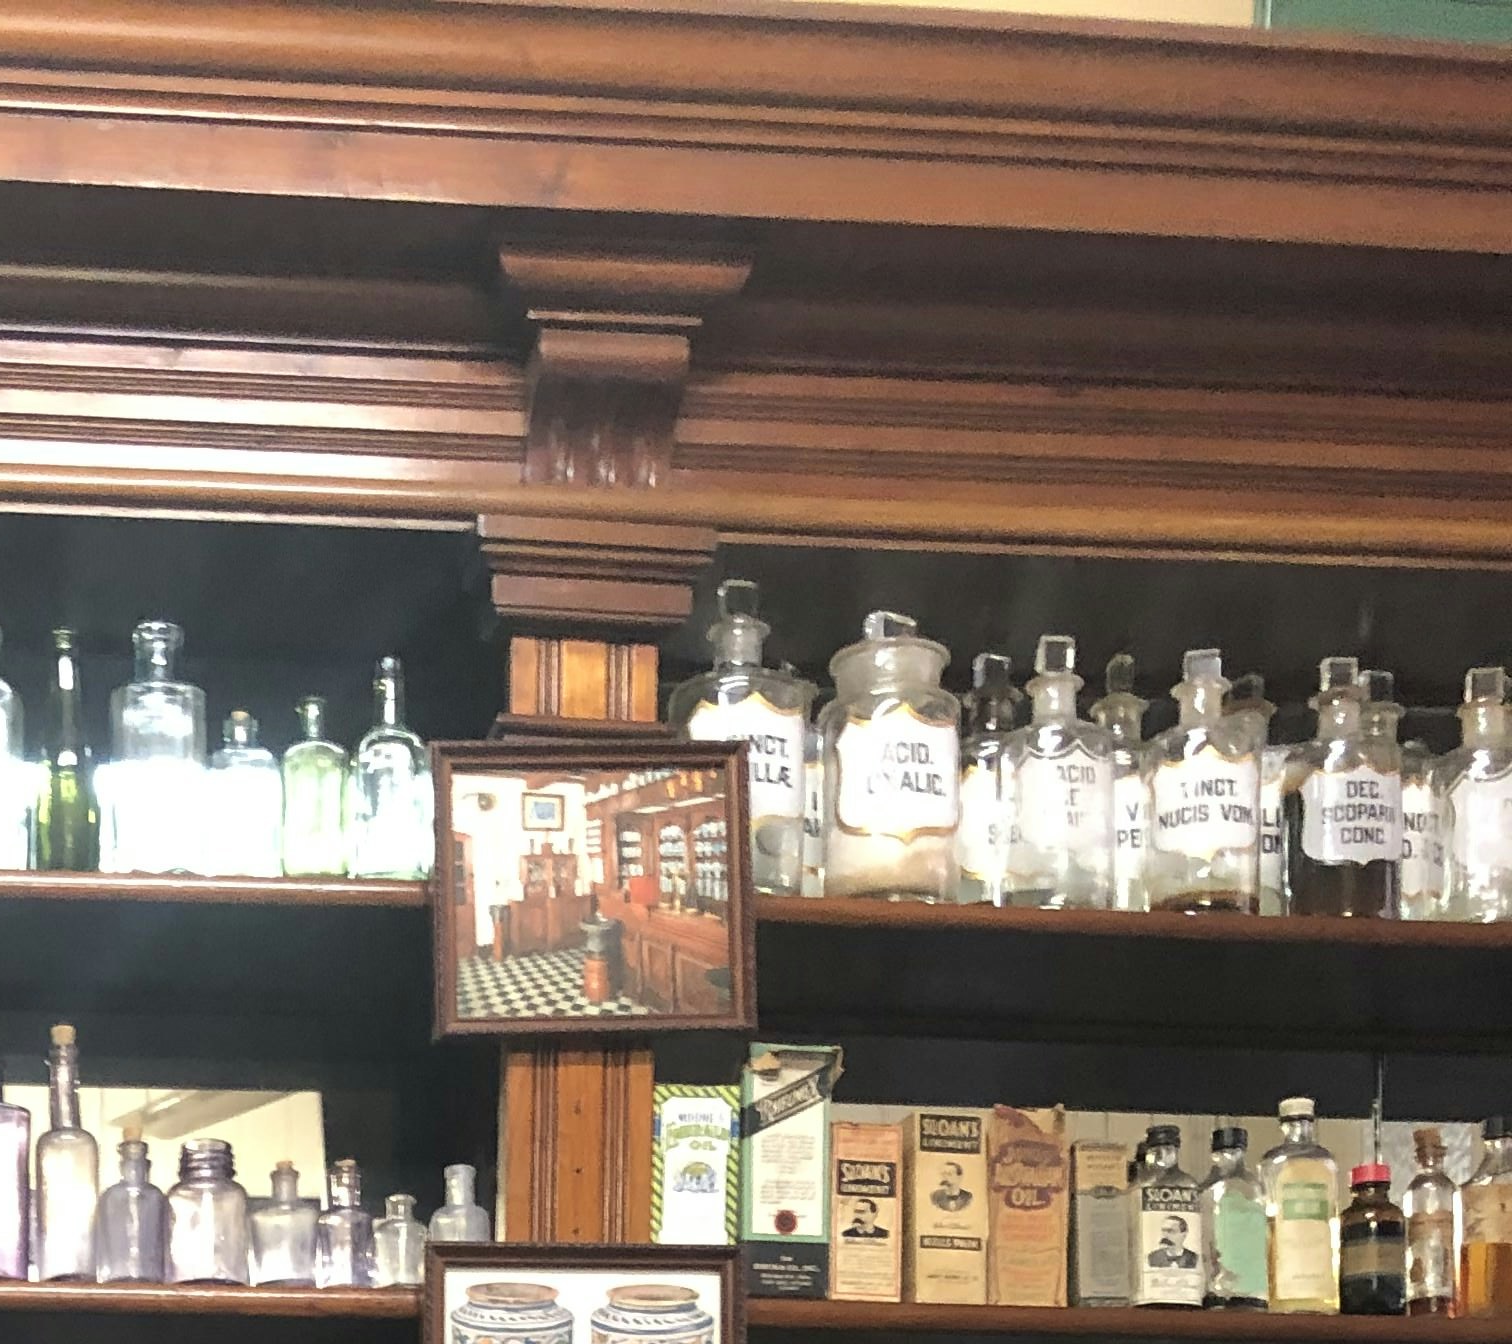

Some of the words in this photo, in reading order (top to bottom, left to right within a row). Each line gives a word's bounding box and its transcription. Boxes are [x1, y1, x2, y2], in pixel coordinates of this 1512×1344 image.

[1159, 804, 1209, 830] NUCIS
[1012, 1187, 1047, 1206] OIL
[1145, 1187, 1201, 1203] SLOAN'S
